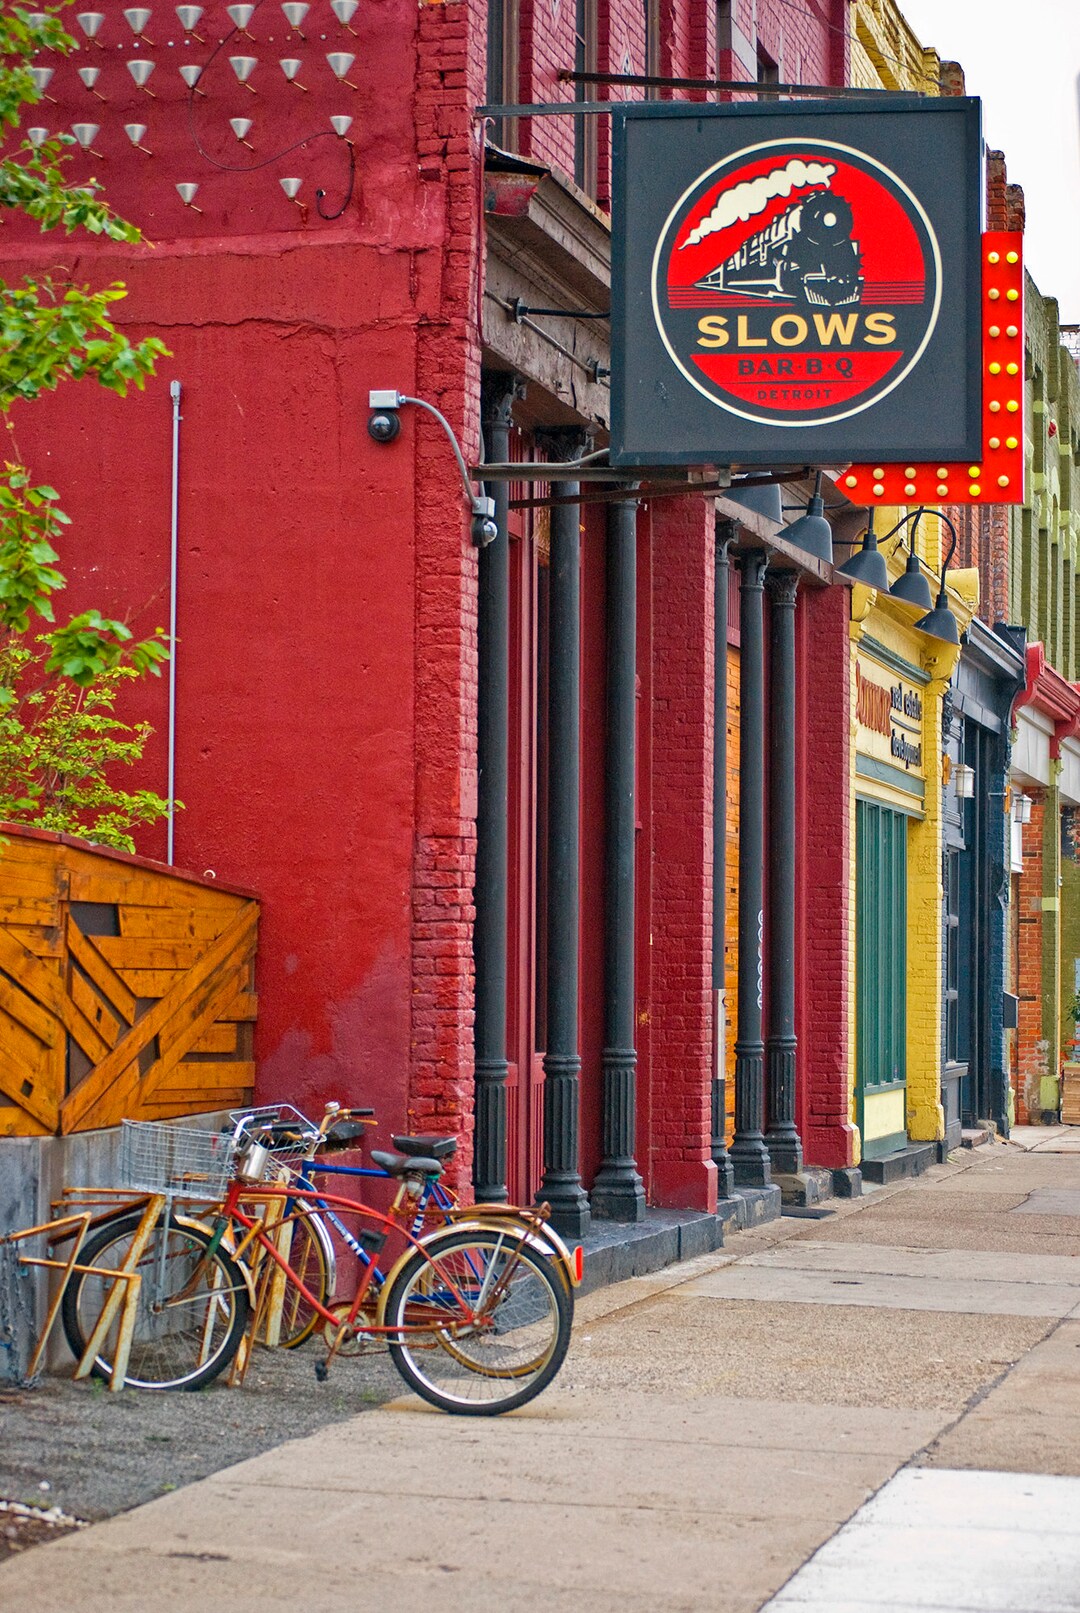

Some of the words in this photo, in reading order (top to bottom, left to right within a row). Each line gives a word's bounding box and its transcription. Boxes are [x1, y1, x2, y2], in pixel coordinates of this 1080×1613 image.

[696, 312, 897, 347] SLOWS
[757, 389, 832, 400] DETROIT
[890, 682, 902, 712] real
[891, 728, 922, 770] development
